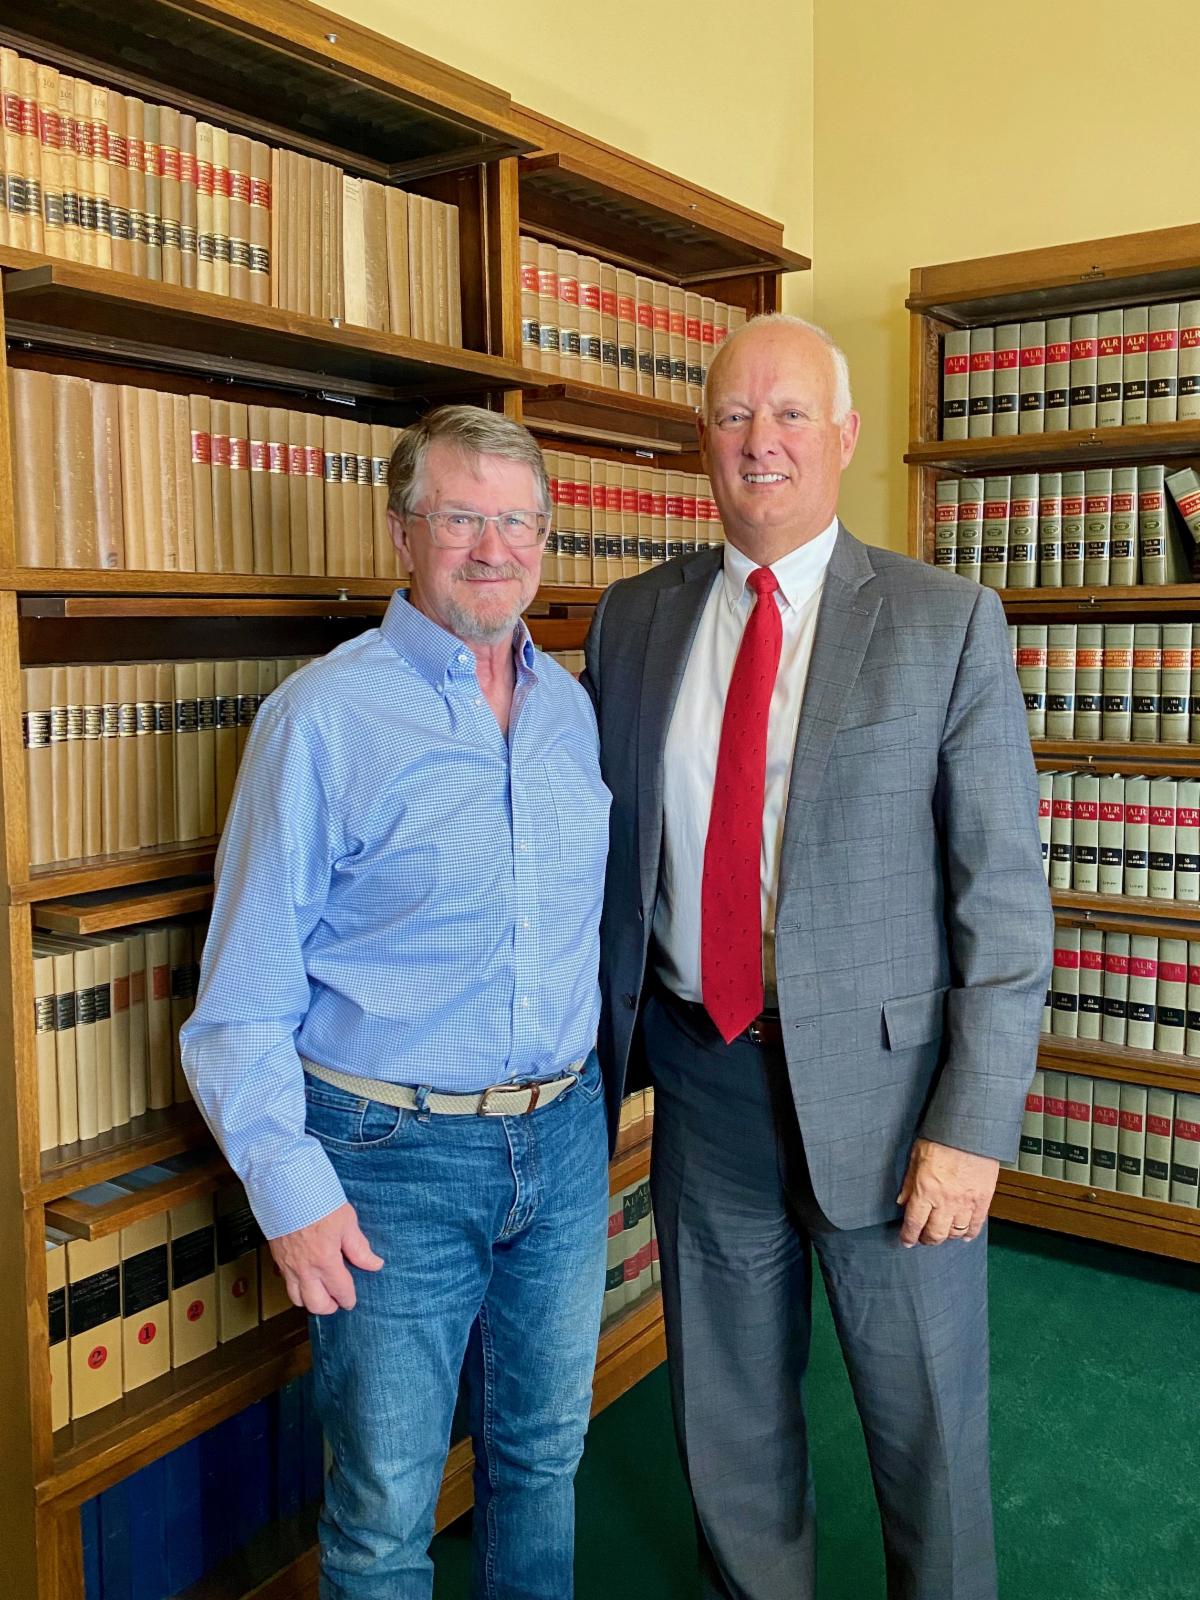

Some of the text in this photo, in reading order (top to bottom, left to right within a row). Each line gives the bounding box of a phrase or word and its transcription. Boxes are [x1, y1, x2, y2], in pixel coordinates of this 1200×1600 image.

[1153, 333, 1173, 343] ALR
[1182, 330, 1200, 340] ALR
[1101, 339, 1118, 348] ALR
[1127, 336, 1145, 346] ALR
[1049, 346, 1067, 355] ALR
[1074, 342, 1092, 351] ALR
[998, 352, 1014, 361] ALR
[1024, 349, 1041, 358] ALR
[948, 358, 965, 367] ALR
[973, 355, 990, 363] ALR
[1055, 803, 1072, 811] ALR
[1078, 804, 1095, 812] ALR
[1102, 806, 1120, 814] ALR
[1128, 808, 1148, 816] ALR
[1152, 809, 1172, 818] ALR
[1179, 810, 1199, 819] ALR
[1083, 954, 1102, 962] ALR
[1109, 958, 1127, 966] ALR
[1135, 961, 1153, 970] ALR
[1045, 1101, 1064, 1110] ALR
[1069, 1104, 1087, 1112] ALR
[1098, 1109, 1115, 1119] ALR
[1122, 1114, 1139, 1123] ALR
[1150, 1118, 1167, 1128] ALR
[1179, 1122, 1197, 1133] ALR
